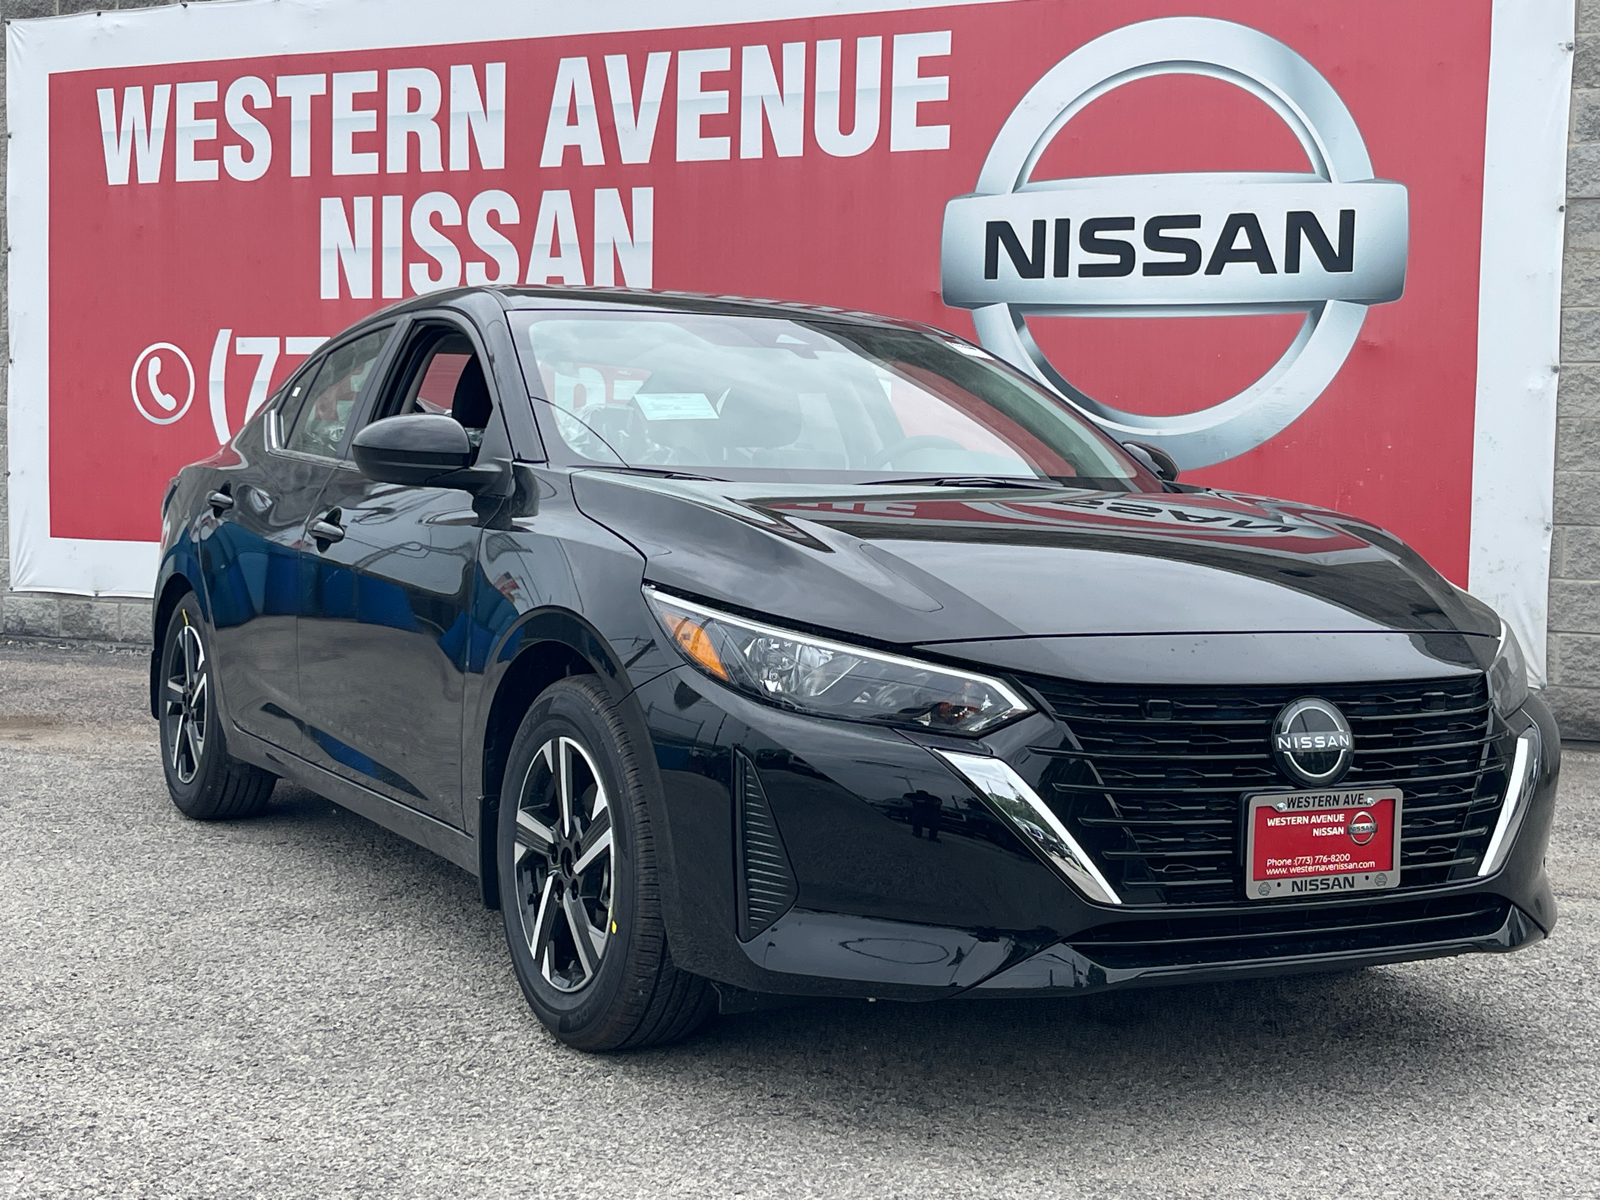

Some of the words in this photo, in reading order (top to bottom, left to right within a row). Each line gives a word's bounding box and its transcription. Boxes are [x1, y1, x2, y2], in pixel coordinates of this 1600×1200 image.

[97, 62, 506, 186] WESTERN
[540, 30, 953, 169] AVENUE
[320, 187, 655, 300] NISSAN
[984, 209, 1356, 280] NISSAN
[1277, 734, 1350, 750] NISSAN
[1287, 795, 1341, 809] WESTERN
[1267, 816, 1309, 827] WESTERN
[1310, 813, 1345, 824] AVENUE
[1312, 826, 1345, 837] NISSAN
[1266, 858, 1292, 867] Phone
[1314, 853, 1351, 864] 776-8200
[1289, 860, 1376, 874] westernavenissan.com
[1291, 876, 1355, 893] NISSAN
